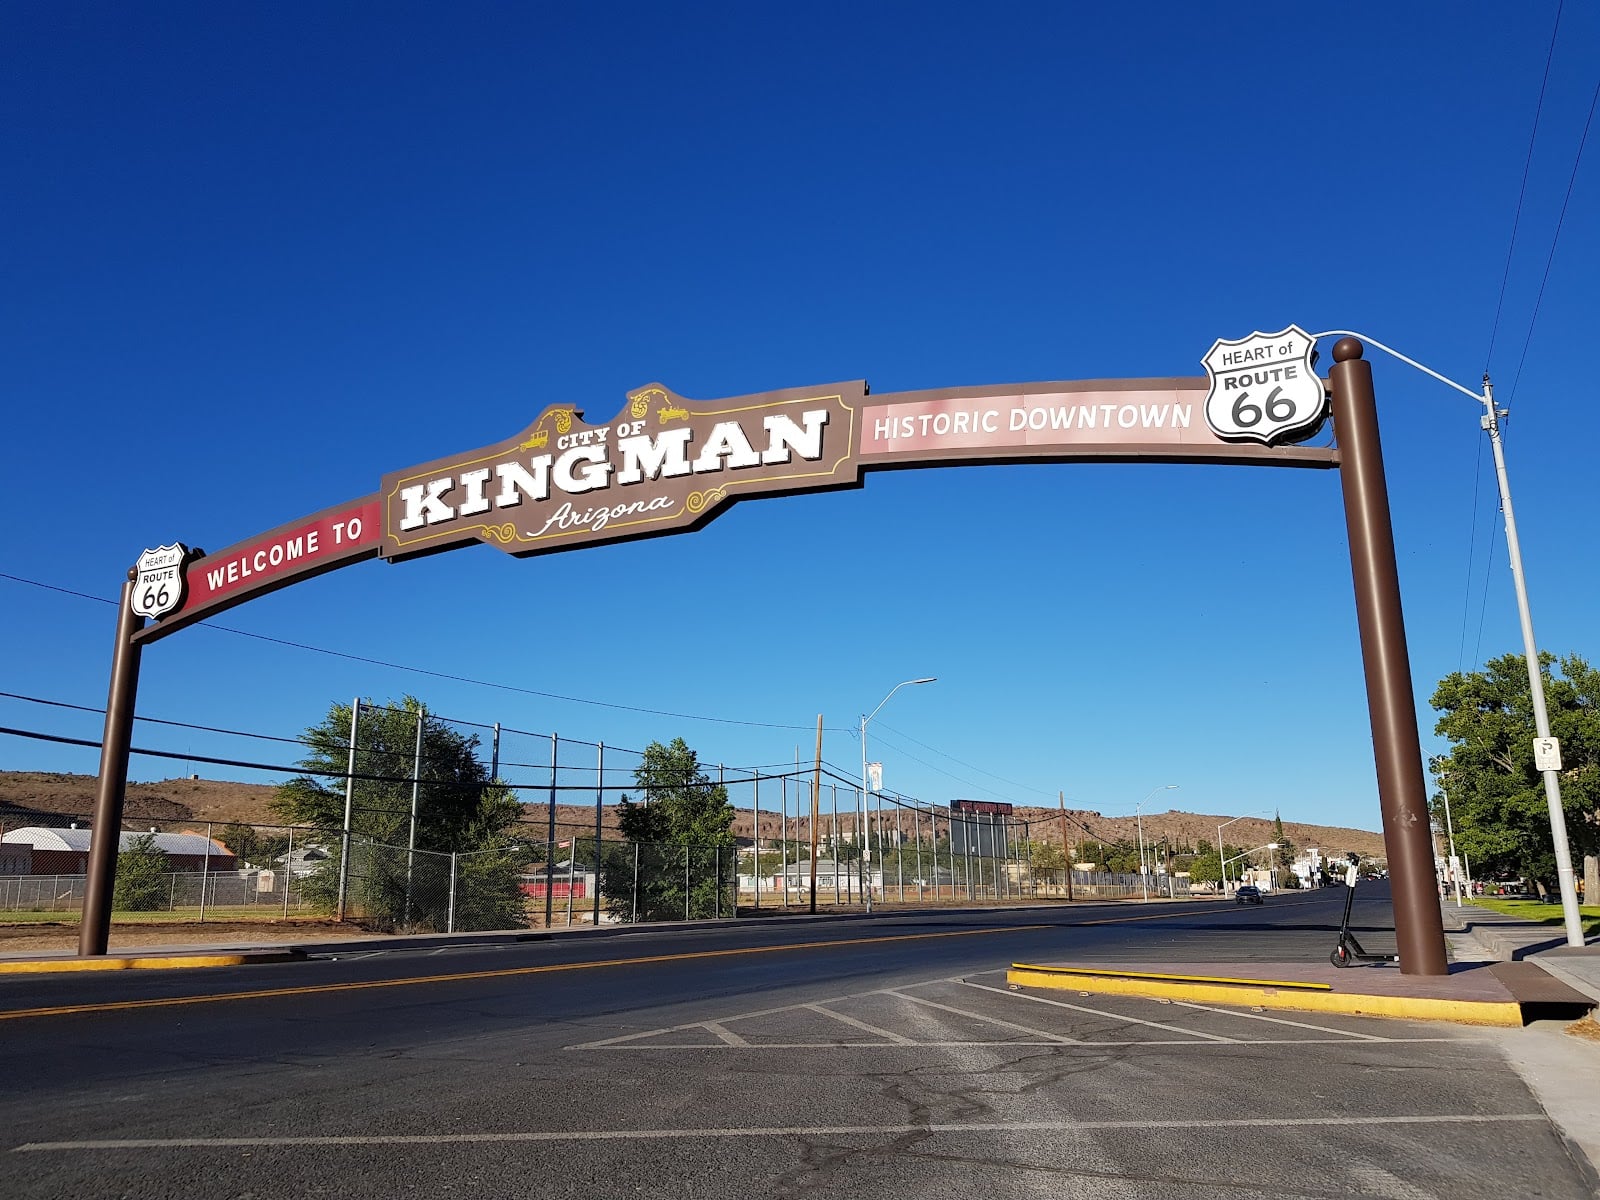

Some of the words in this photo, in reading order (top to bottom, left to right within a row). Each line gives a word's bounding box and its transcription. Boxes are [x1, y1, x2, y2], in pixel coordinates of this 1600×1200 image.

[1223, 345, 1273, 366] HEART
[1279, 341, 1293, 355] of
[1224, 366, 1298, 391] ROUTE
[873, 410, 999, 440] HISTORIC
[1009, 403, 1192, 432] DOWNTOWN
[1232, 386, 1296, 428] 66
[557, 427, 610, 450] CITY
[617, 420, 646, 438] OF
[400, 410, 827, 532] KINGMAN
[526, 495, 675, 537] Arizona
[145, 555, 168, 567] HEART
[168, 554, 175, 563] of
[207, 531, 319, 591] WELCOME
[332, 518, 362, 544] TO
[143, 570, 174, 584] ROUTE
[142, 583, 169, 609] 66
